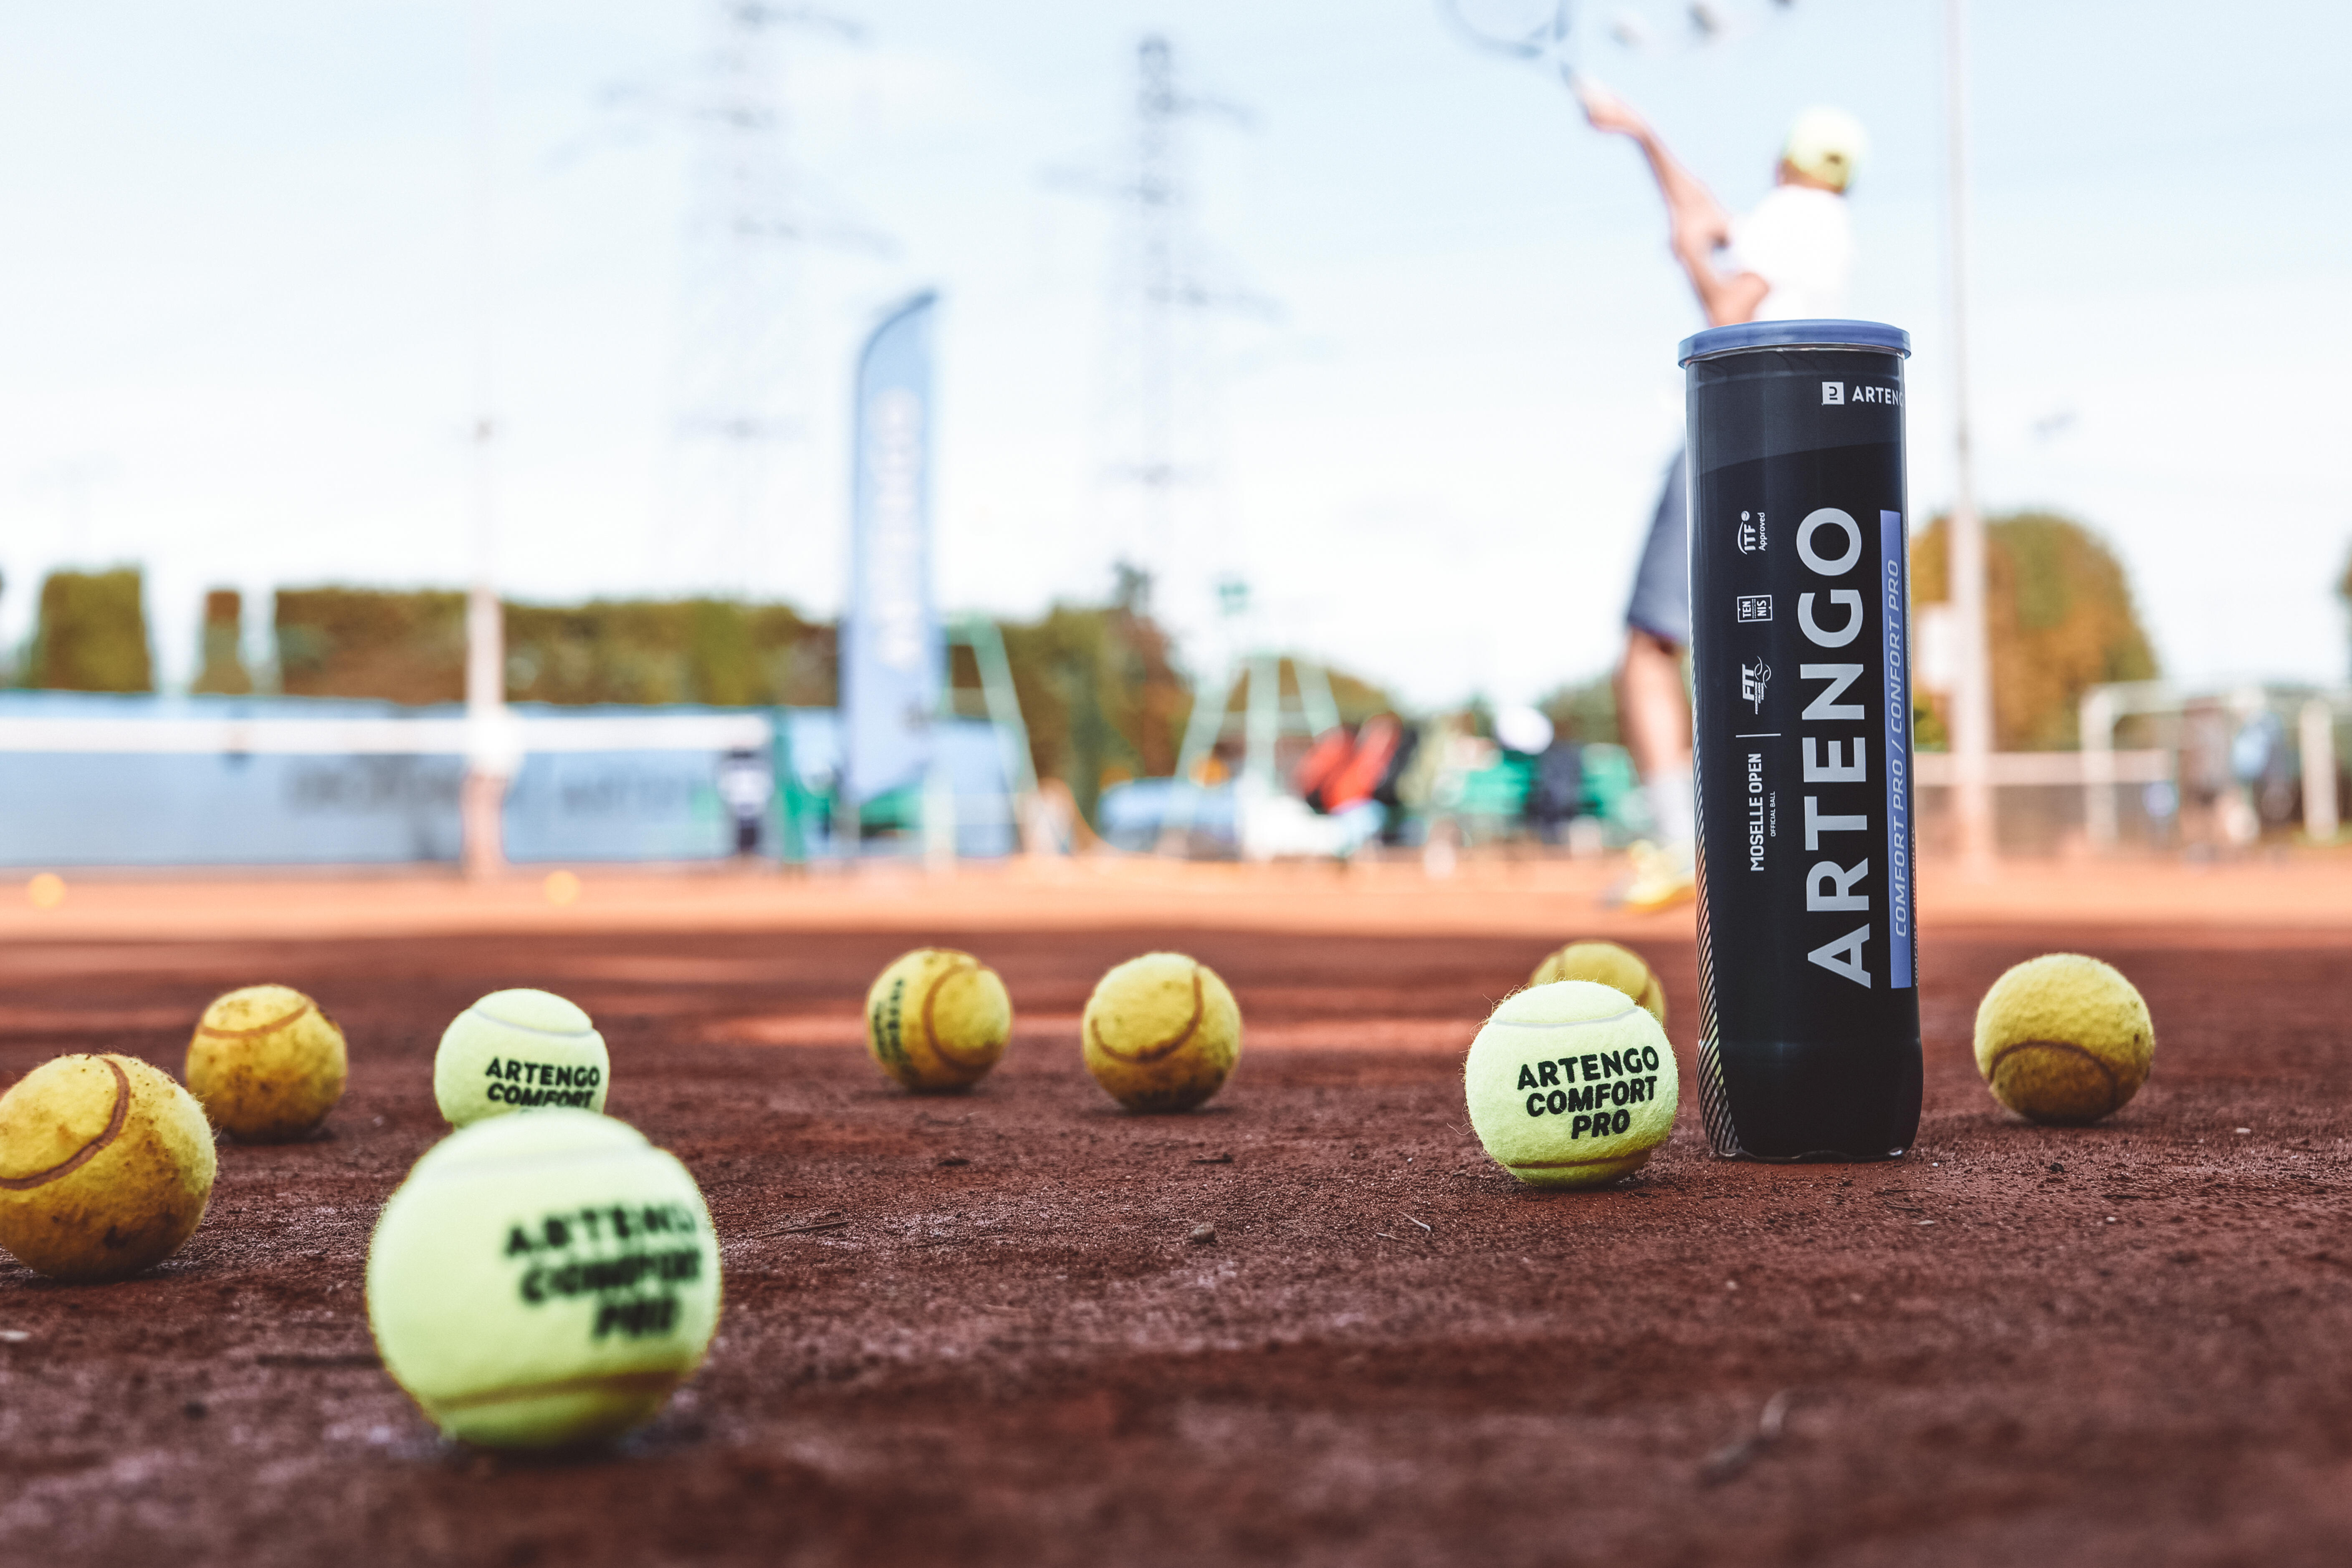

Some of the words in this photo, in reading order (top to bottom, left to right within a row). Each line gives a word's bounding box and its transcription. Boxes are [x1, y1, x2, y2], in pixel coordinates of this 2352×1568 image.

[1744, 524, 1756, 551] ITF
[1757, 512, 1768, 551] Approved
[1888, 559, 1899, 612] PRO
[1742, 601, 1751, 618] TEN
[1757, 600, 1767, 617] NIS
[1742, 663, 1755, 701] FIT
[1889, 615, 1902, 734] CONFORT
[1796, 507, 1871, 989] ARTENGO
[1892, 738, 1904, 754] /
[1748, 753, 1763, 794] OPEN
[1892, 759, 1904, 812] PRO
[1749, 797, 1765, 872] MOSELLE
[1894, 816, 1906, 937] COMFORT
[486, 1056, 600, 1088] ARTENGO
[1517, 1046, 1659, 1090] ARTENGO
[1526, 1076, 1657, 1117] COMFORT
[1571, 1109, 1630, 1139] PRO
